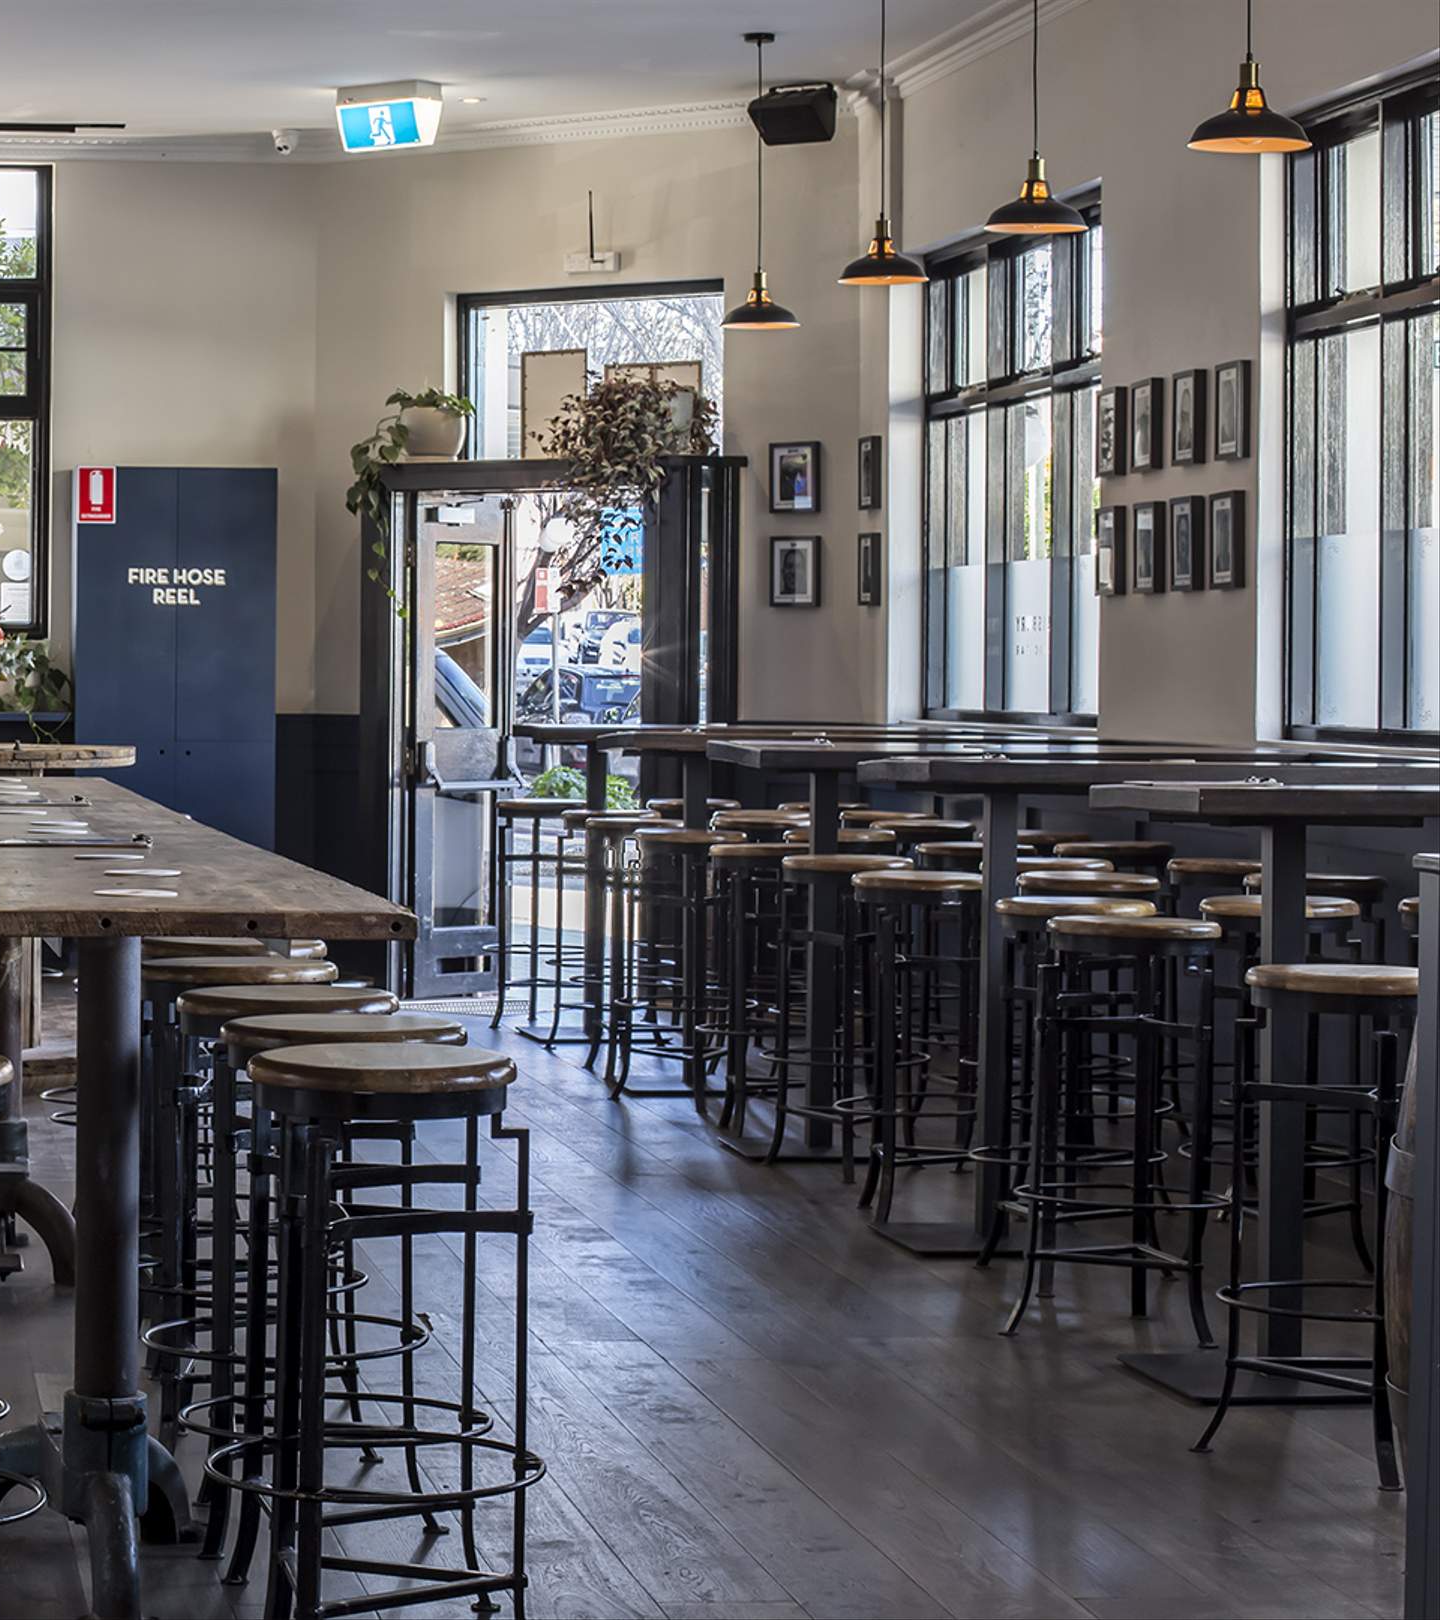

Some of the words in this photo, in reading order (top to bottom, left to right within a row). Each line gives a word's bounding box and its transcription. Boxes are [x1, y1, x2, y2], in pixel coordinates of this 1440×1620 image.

[128, 568, 169, 585] FIRE
[173, 568, 227, 586] HOSE
[152, 588, 201, 605] REEL
